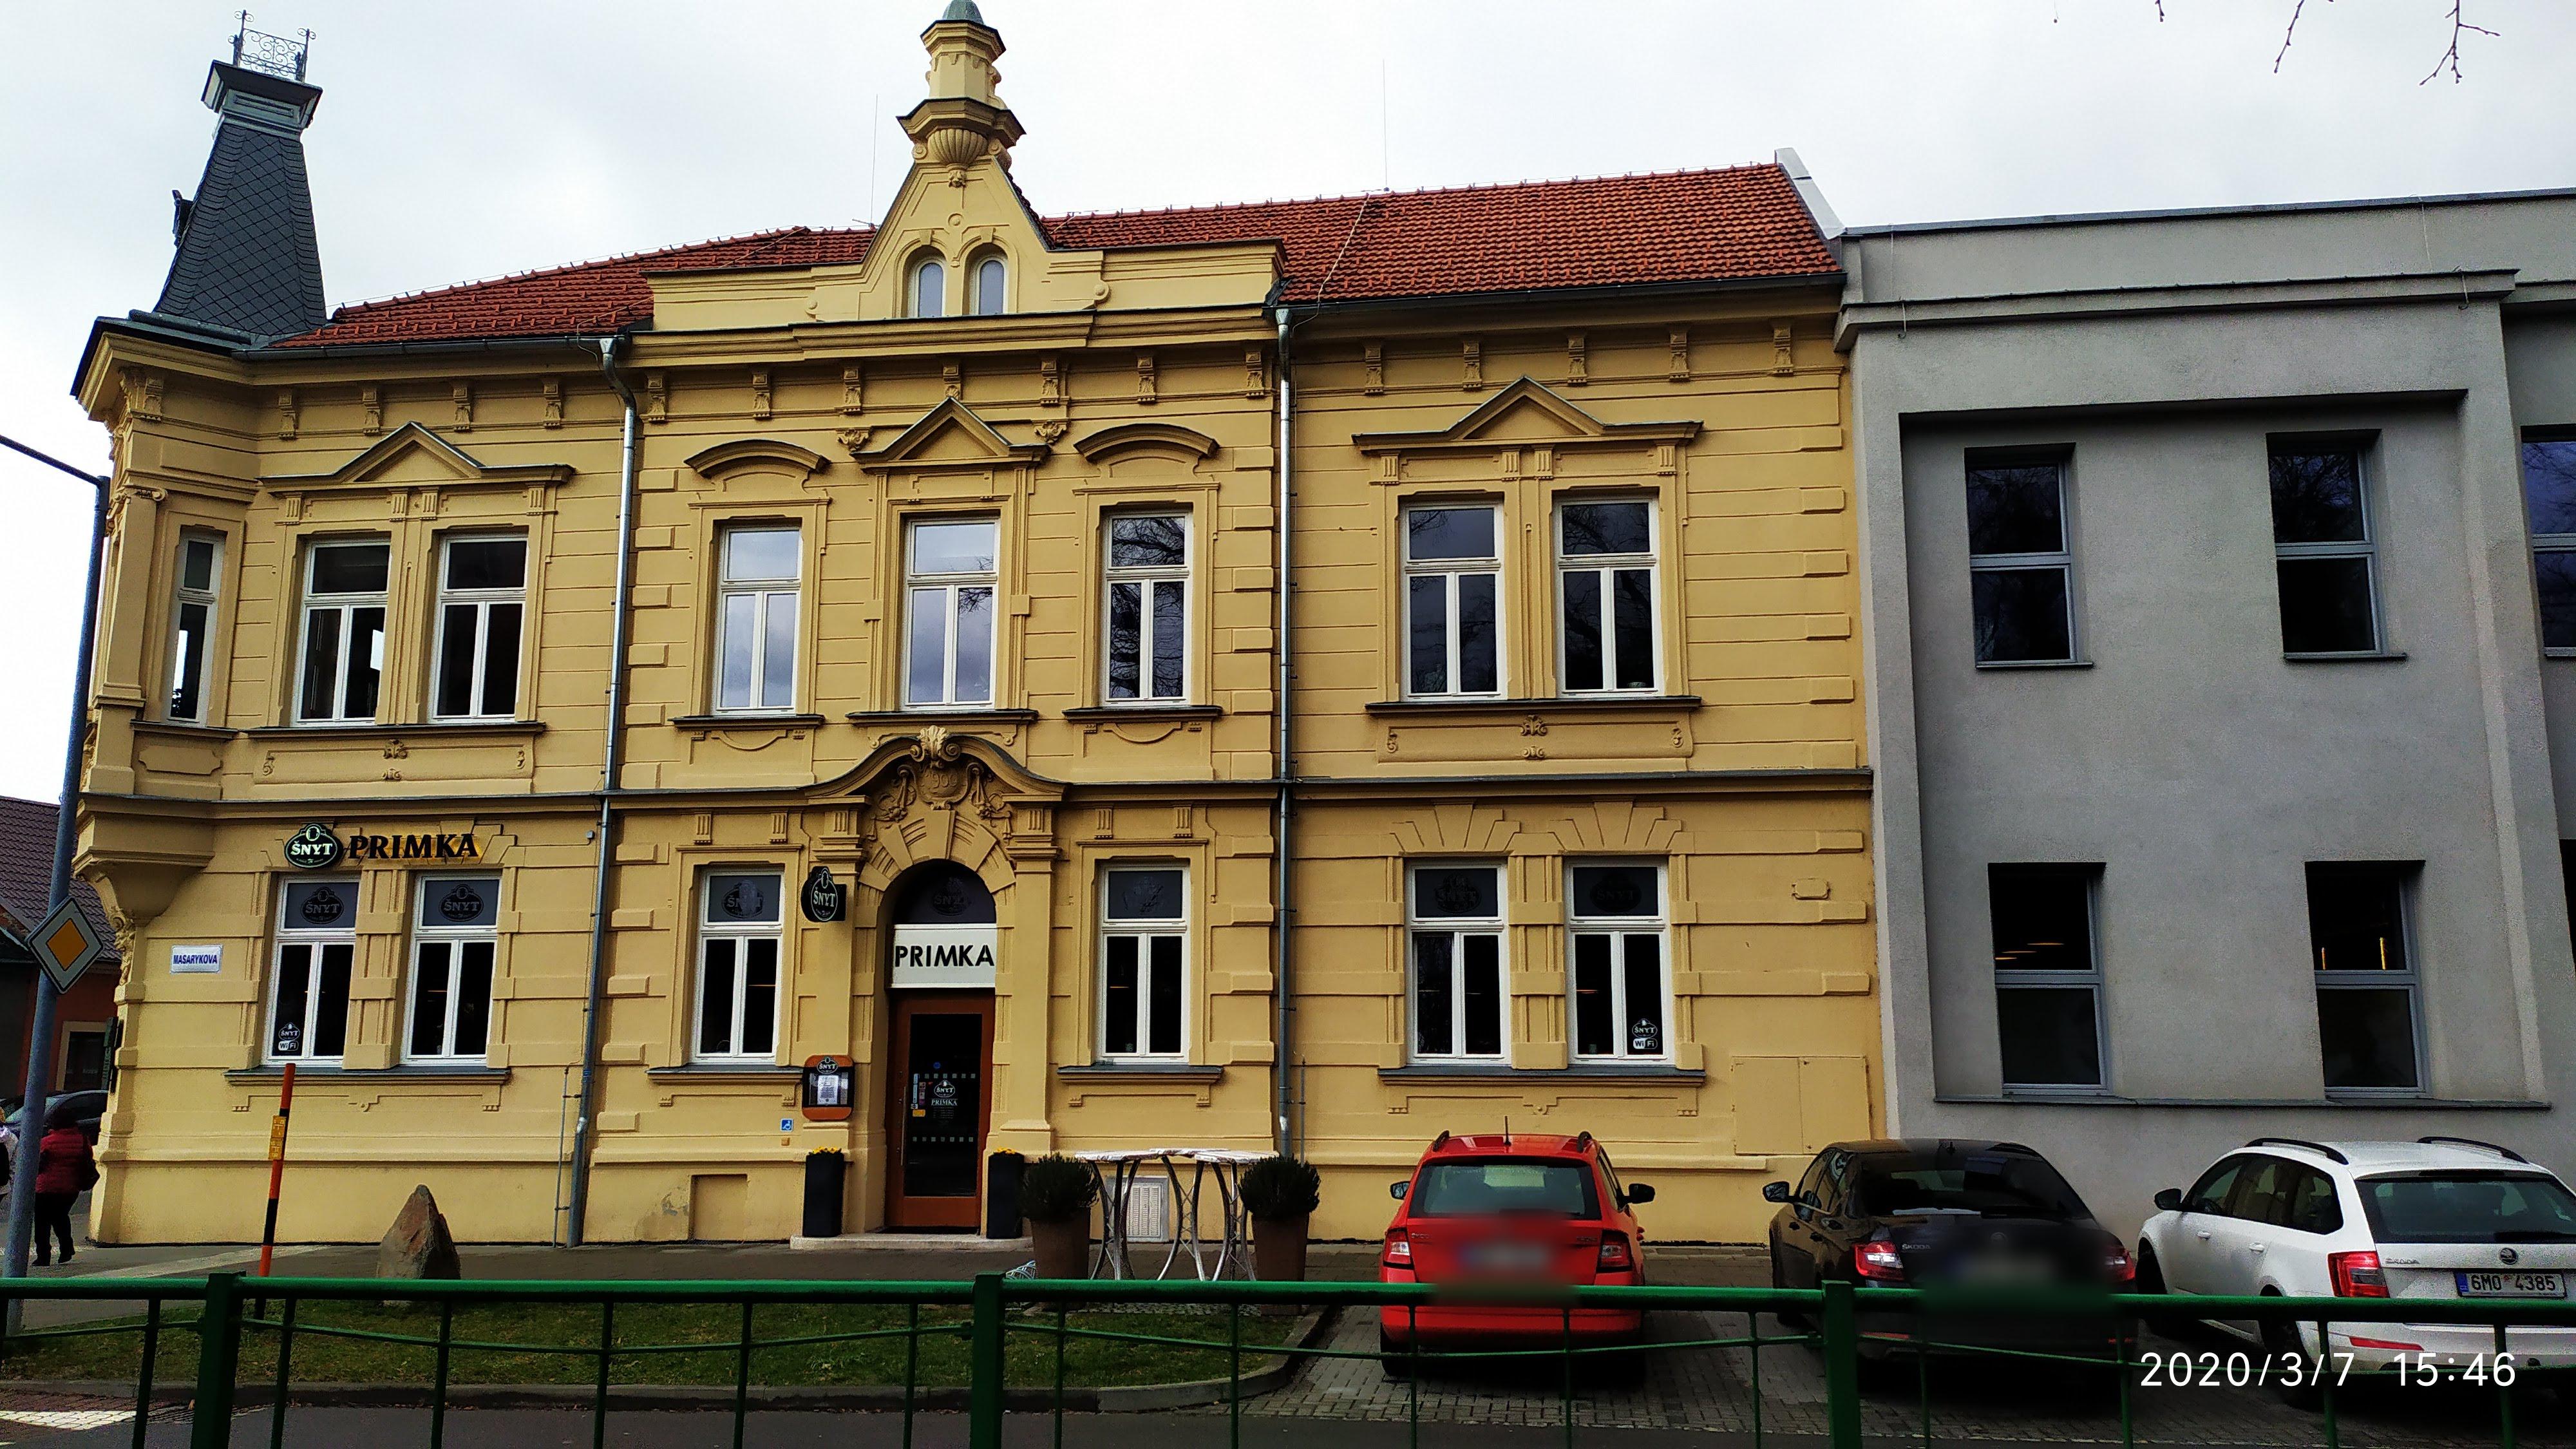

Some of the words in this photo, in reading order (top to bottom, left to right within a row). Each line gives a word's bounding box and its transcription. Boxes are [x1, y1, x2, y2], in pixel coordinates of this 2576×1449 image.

[290, 840, 333, 855] ŠNYT
[348, 833, 478, 859] PRIMKA
[444, 898, 480, 911] ŠNYT
[813, 887, 836, 907] ŠNYT
[305, 901, 339, 913] ŠNYT
[173, 954, 218, 964] MASARYKOVA
[895, 945, 995, 967] PRIMKA
[2515, 1275, 2556, 1291] 4385
